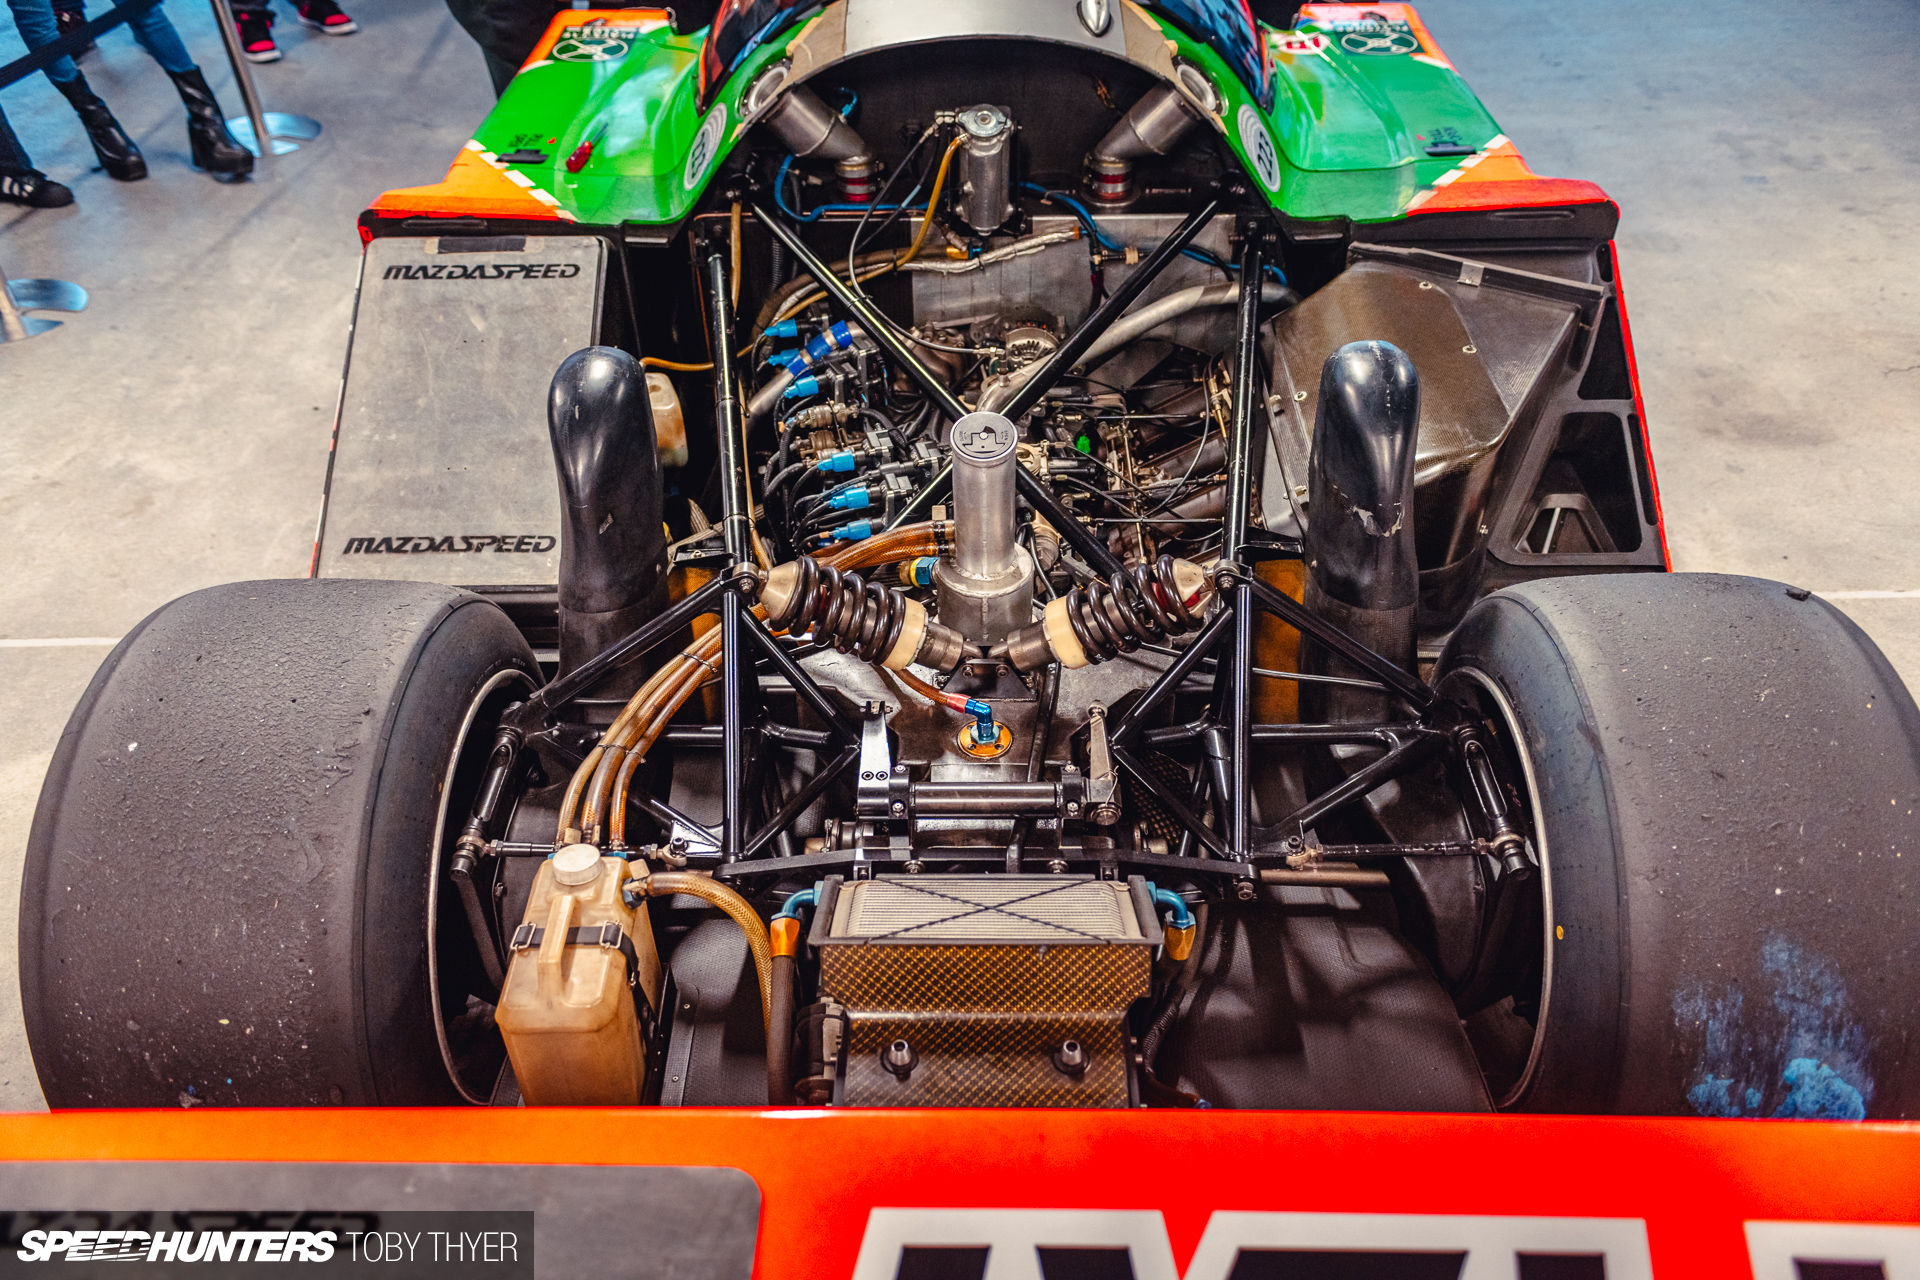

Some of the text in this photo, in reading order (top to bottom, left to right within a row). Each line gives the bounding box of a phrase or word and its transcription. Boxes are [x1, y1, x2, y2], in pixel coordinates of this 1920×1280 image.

[1257, 130, 1273, 182] 223
[382, 263, 581, 280] MAZDASPEED
[342, 535, 557, 555] MAZDASPEED
